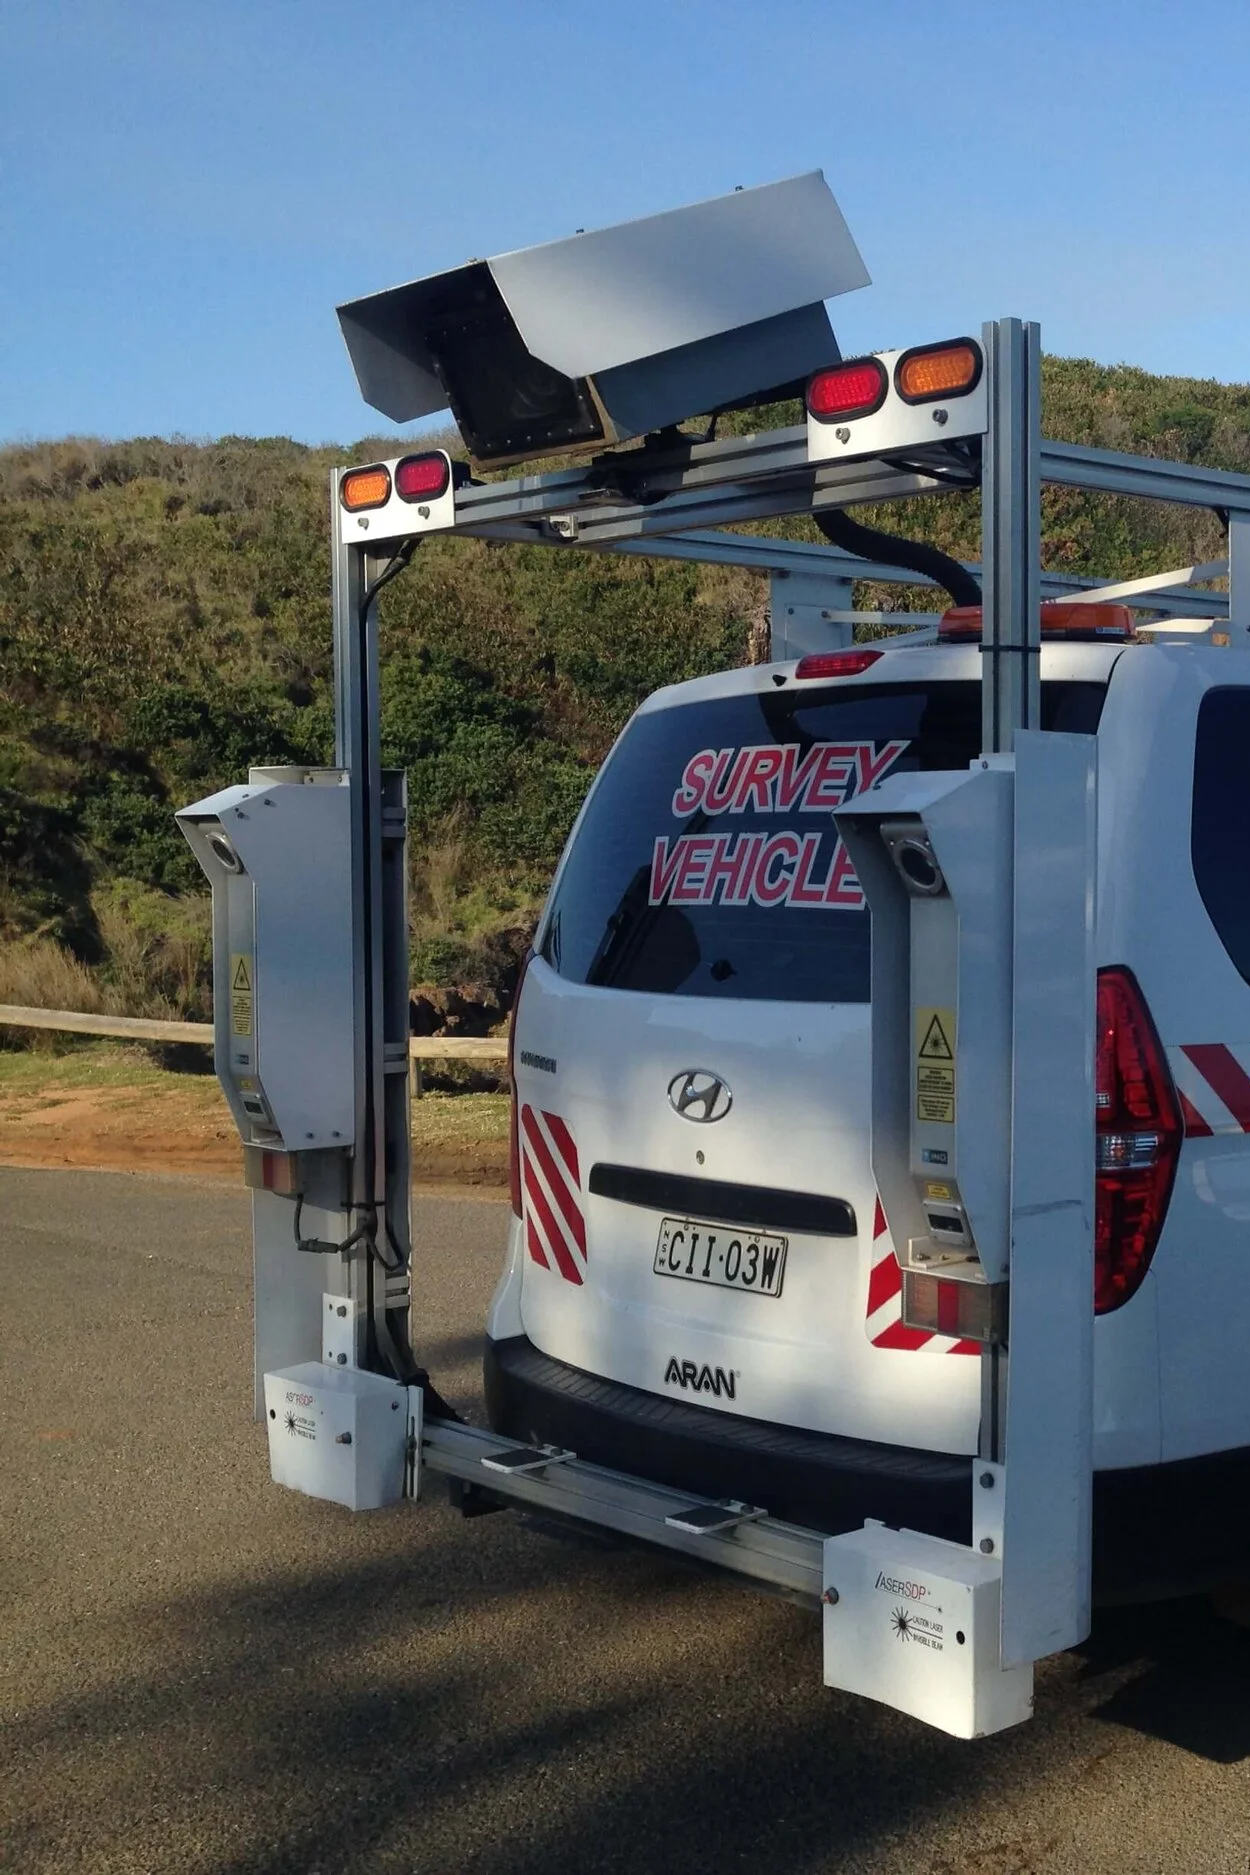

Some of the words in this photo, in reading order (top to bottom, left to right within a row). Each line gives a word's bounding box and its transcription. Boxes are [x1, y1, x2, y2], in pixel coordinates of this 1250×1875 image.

[672, 740, 911, 818] SURVEY
[648, 831, 866, 911] VEHICLE
[664, 1356, 736, 1401] ARAN
